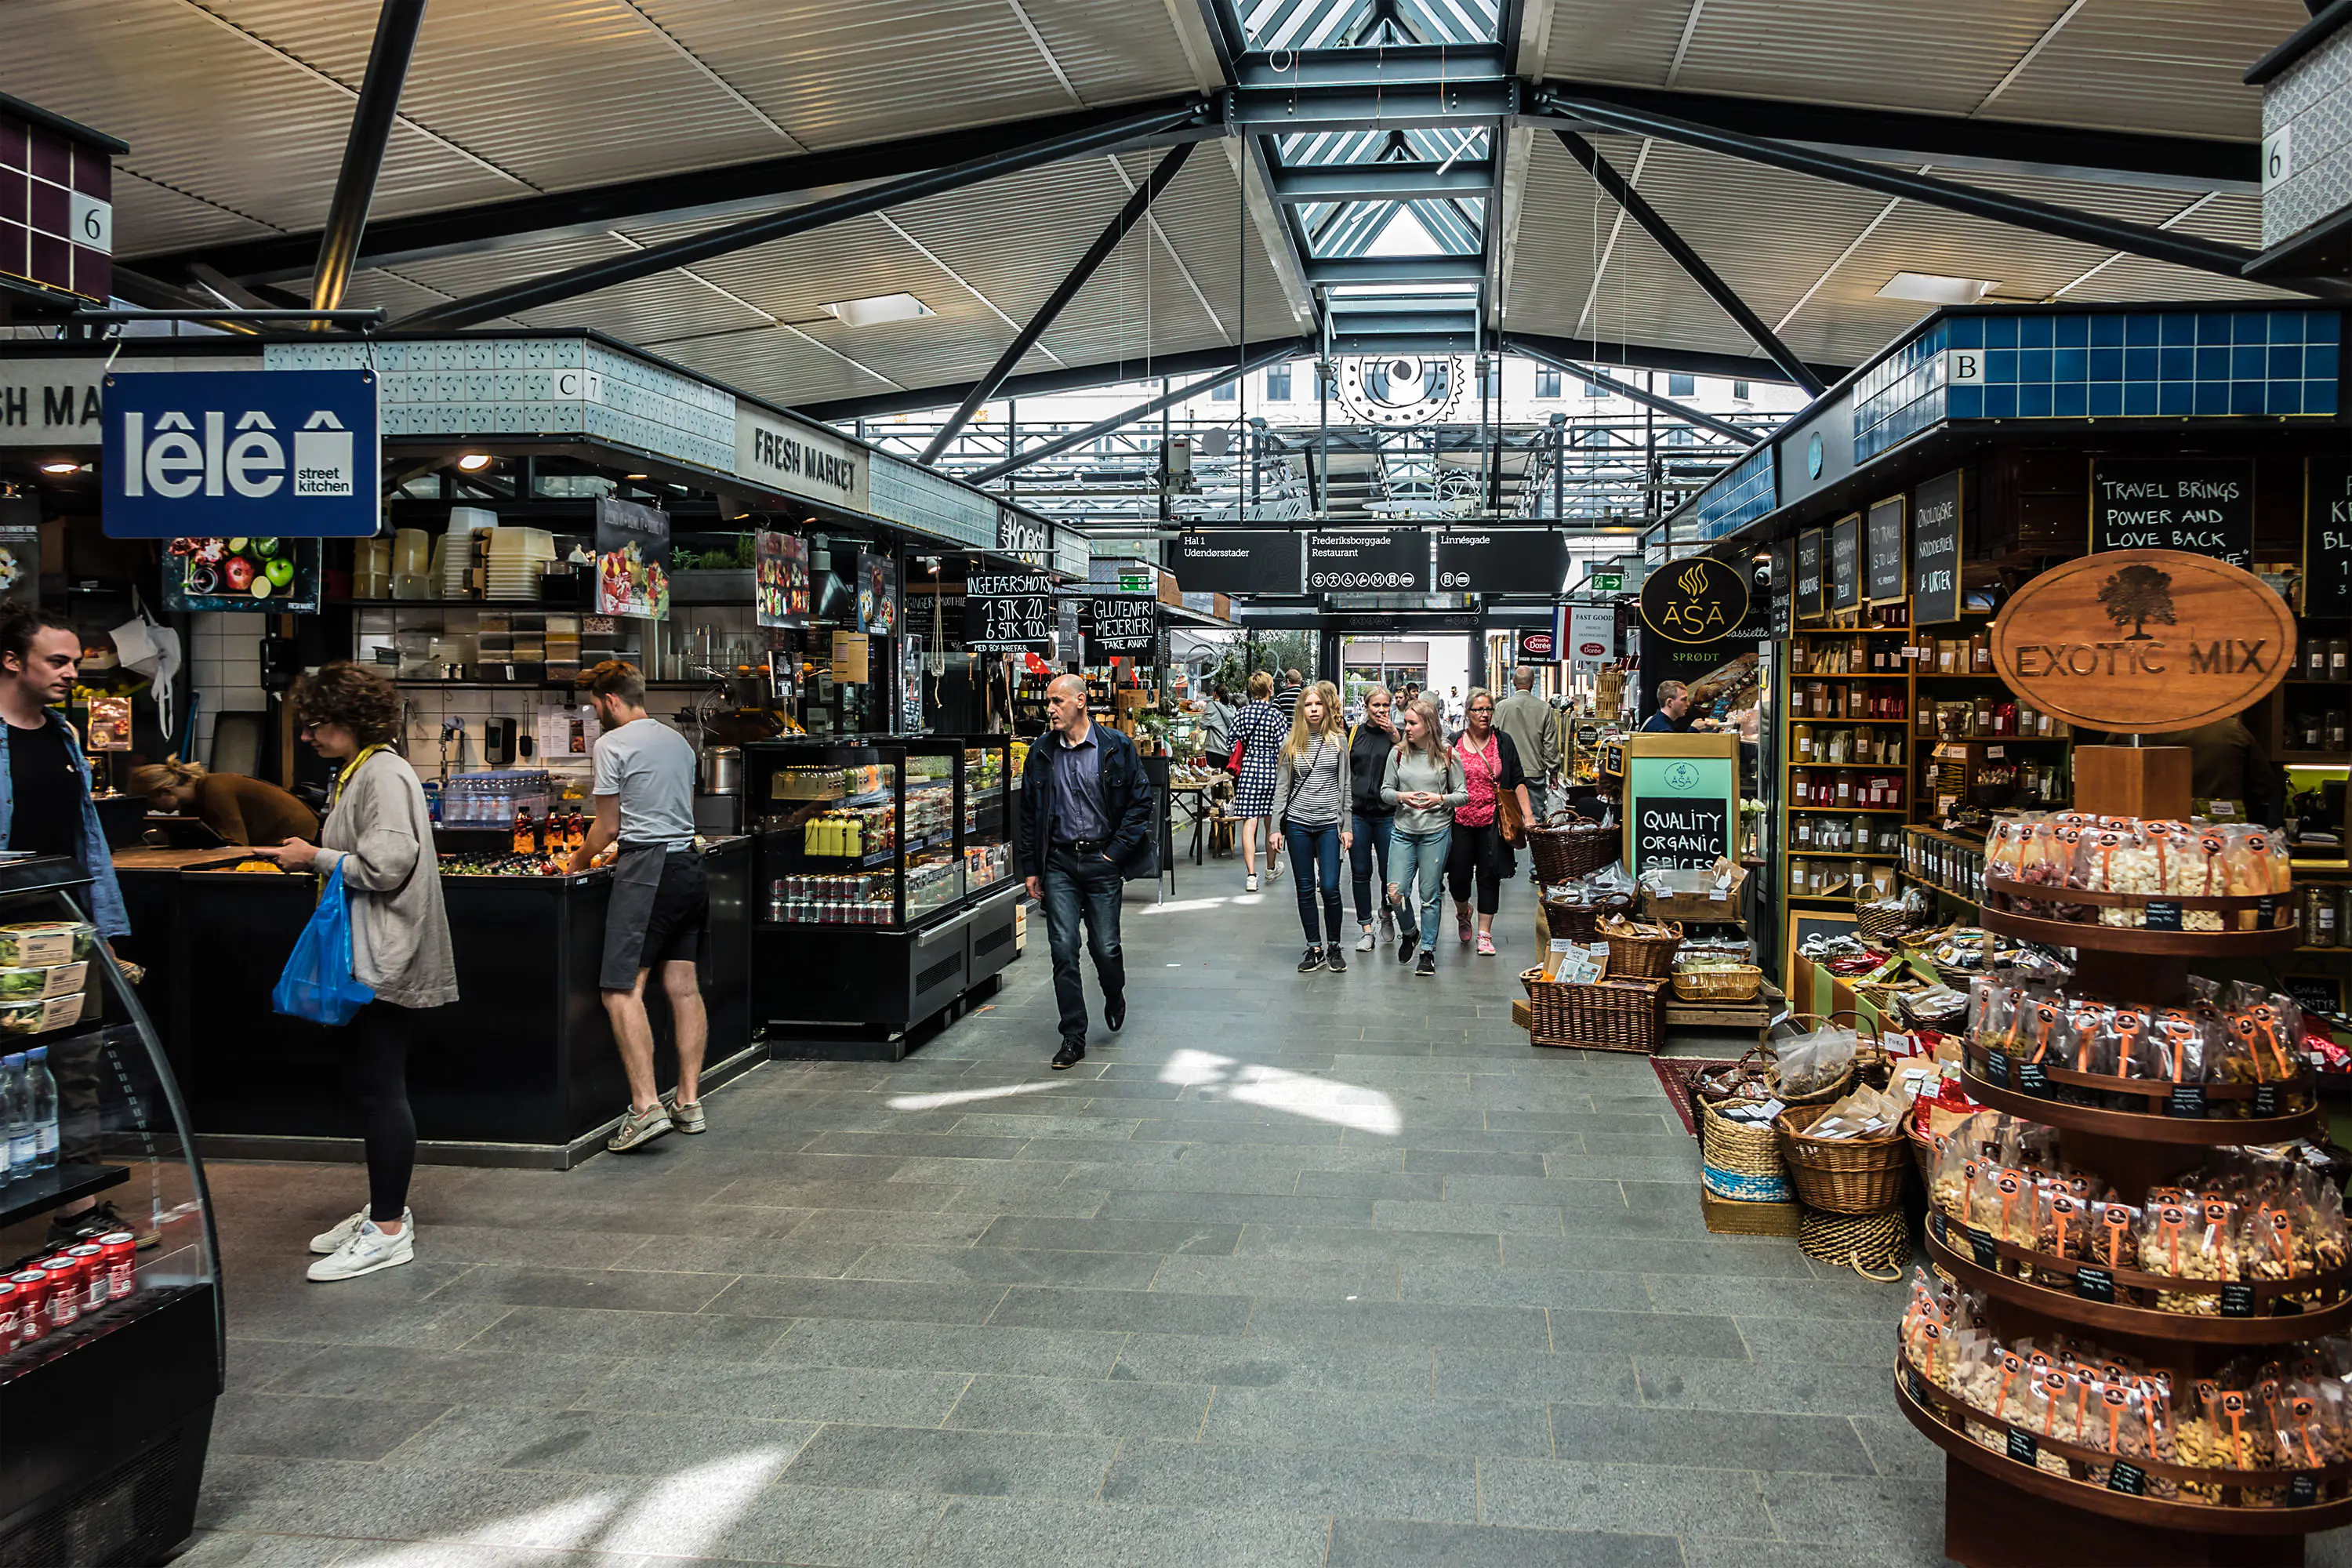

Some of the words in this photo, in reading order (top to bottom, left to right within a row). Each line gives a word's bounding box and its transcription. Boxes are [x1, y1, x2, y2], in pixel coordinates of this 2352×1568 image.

[2270, 140, 2281, 179] 6
[85, 209, 100, 239] 6
[1956, 356, 1976, 379] B
[560, 374, 576, 395] C
[590, 376, 597, 397] 7
[0, 387, 27, 426] H
[755, 427, 800, 475] FRESH
[805, 446, 855, 492] MARKET
[298, 467, 339, 479] street
[298, 480, 350, 492] kitchen
[2107, 509, 2172, 526] POWER
[2181, 510, 2223, 524] AND
[1312, 536, 1392, 546] Frederiksborggade
[1440, 535, 1490, 546] Linnésgade
[2107, 532, 2161, 547] LOVE
[2172, 531, 2226, 547] BACK
[1184, 549, 1250, 557] Udendørsstader
[967, 575, 1050, 593] INGEFÆRSHOTS
[1929, 570, 1951, 593] URTER
[982, 601, 994, 621] 1
[998, 600, 1022, 621] STK
[1094, 601, 1153, 619] GLUTENFRI
[986, 623, 995, 639] 6
[998, 622, 1022, 639] STK
[1096, 618, 1153, 637] MEJERIFRI
[1102, 641, 1125, 650] TAKE
[1127, 638, 1148, 648] AWAY
[1672, 652, 1719, 662] SPRØDT
[2016, 641, 2165, 677] EXOTIC
[2189, 637, 2267, 673] MIX
[1644, 809, 1721, 831] QUALITY
[1642, 834, 1721, 855] ORGANIC
